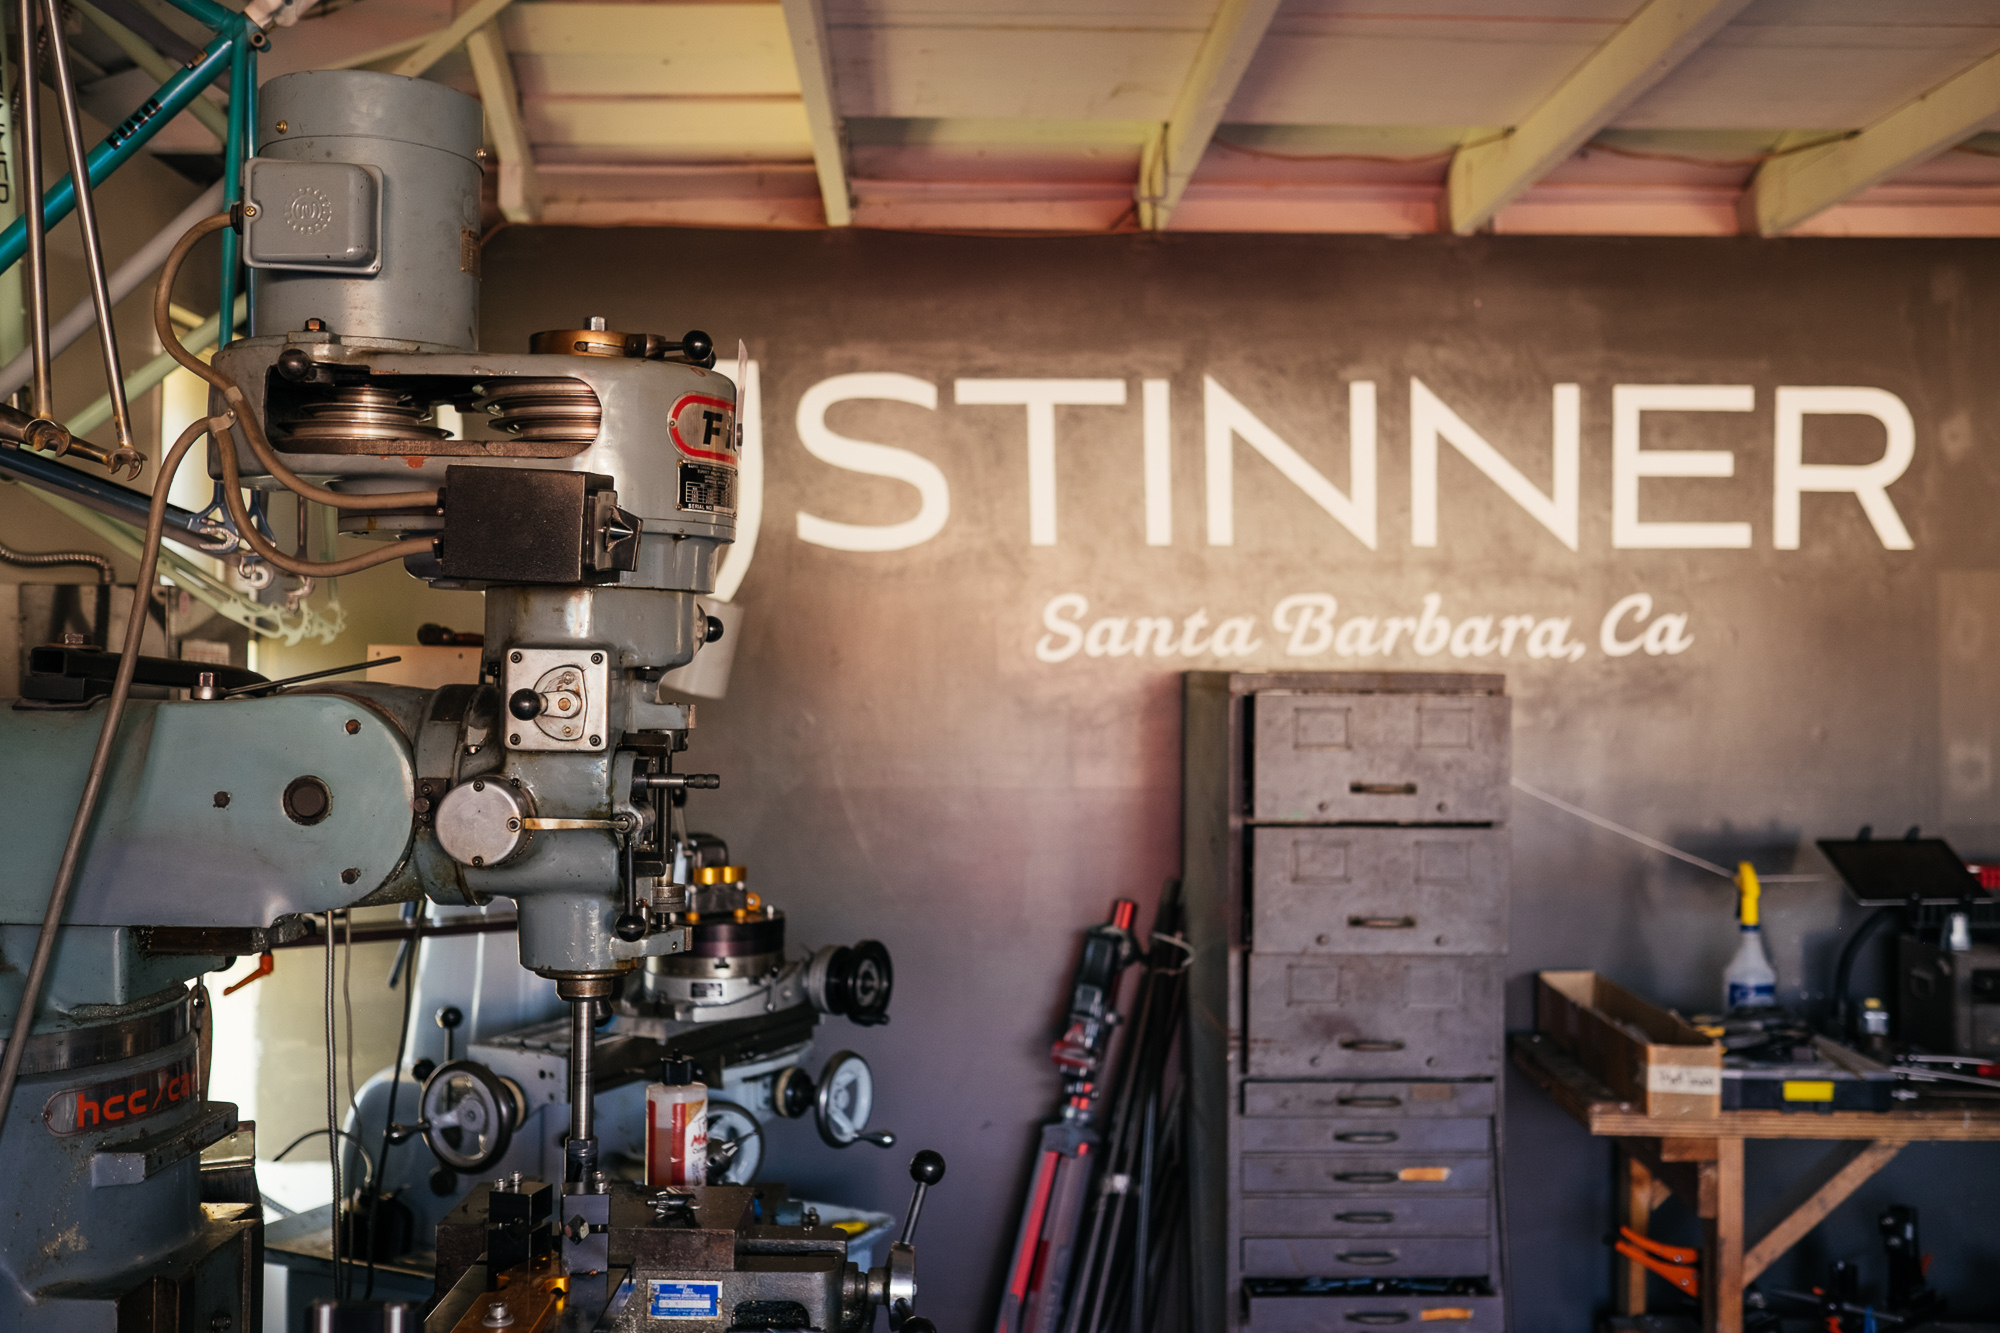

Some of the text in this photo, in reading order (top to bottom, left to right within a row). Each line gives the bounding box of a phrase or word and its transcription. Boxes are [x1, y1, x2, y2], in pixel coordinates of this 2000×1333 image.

[106, 97, 163, 150] FUSO
[796, 372, 1916, 552] STINNER
[1035, 593, 1694, 663] Santa Barbara, Ca
